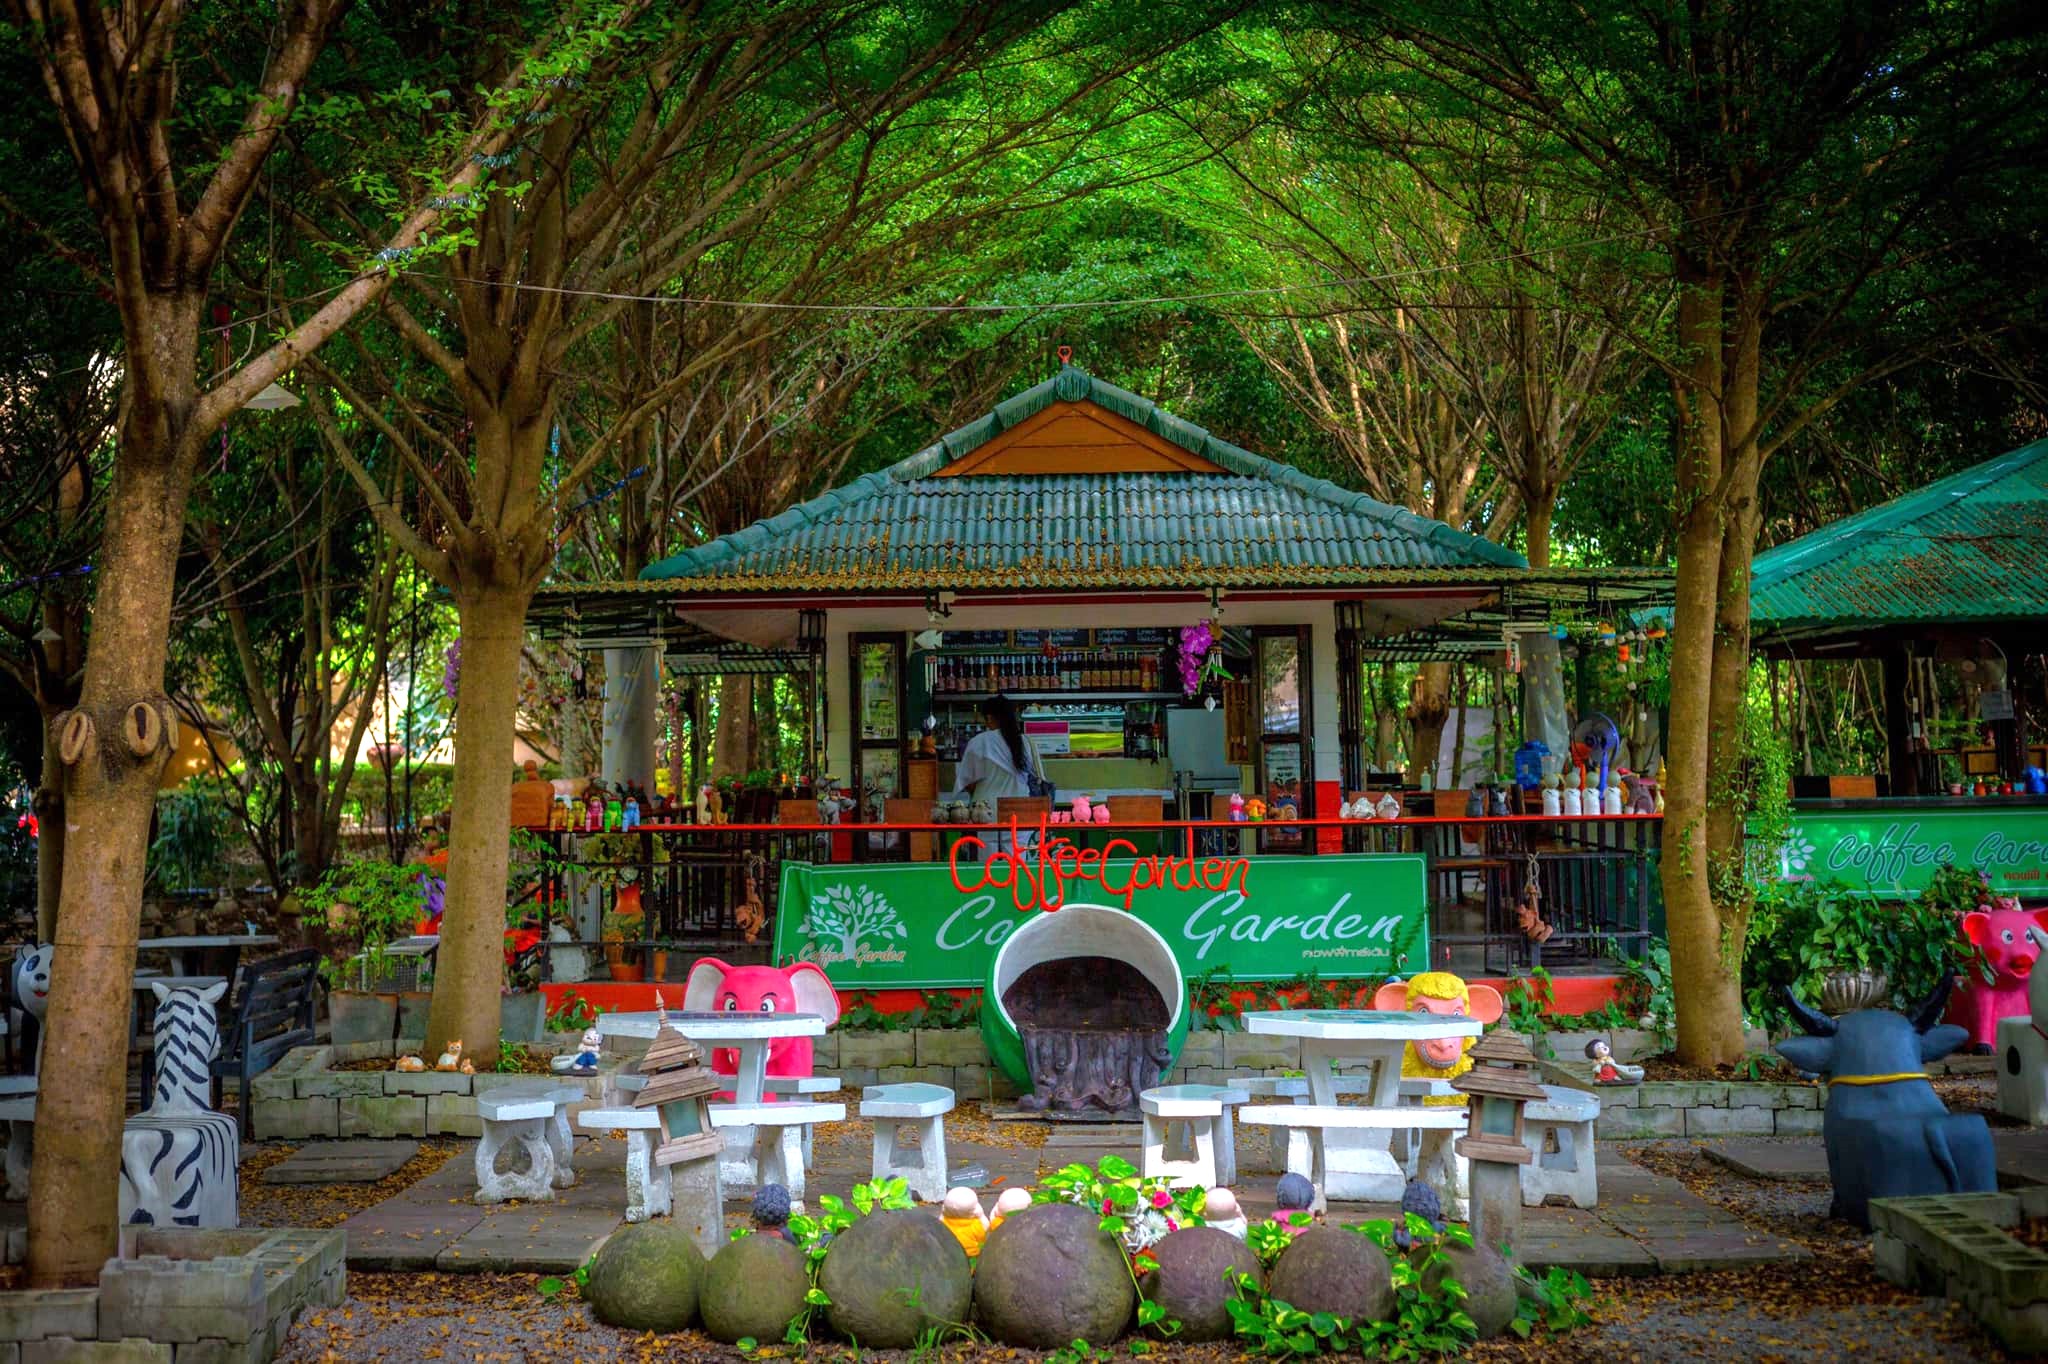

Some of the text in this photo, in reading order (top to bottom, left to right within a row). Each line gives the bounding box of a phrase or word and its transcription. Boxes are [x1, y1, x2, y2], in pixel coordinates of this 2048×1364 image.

[950, 812, 1250, 912] Coffee Garden
[1827, 822, 2048, 884] Coffee Gar
[799, 942, 907, 969] Coffee Garden
[1183, 889, 1403, 960] Garden
